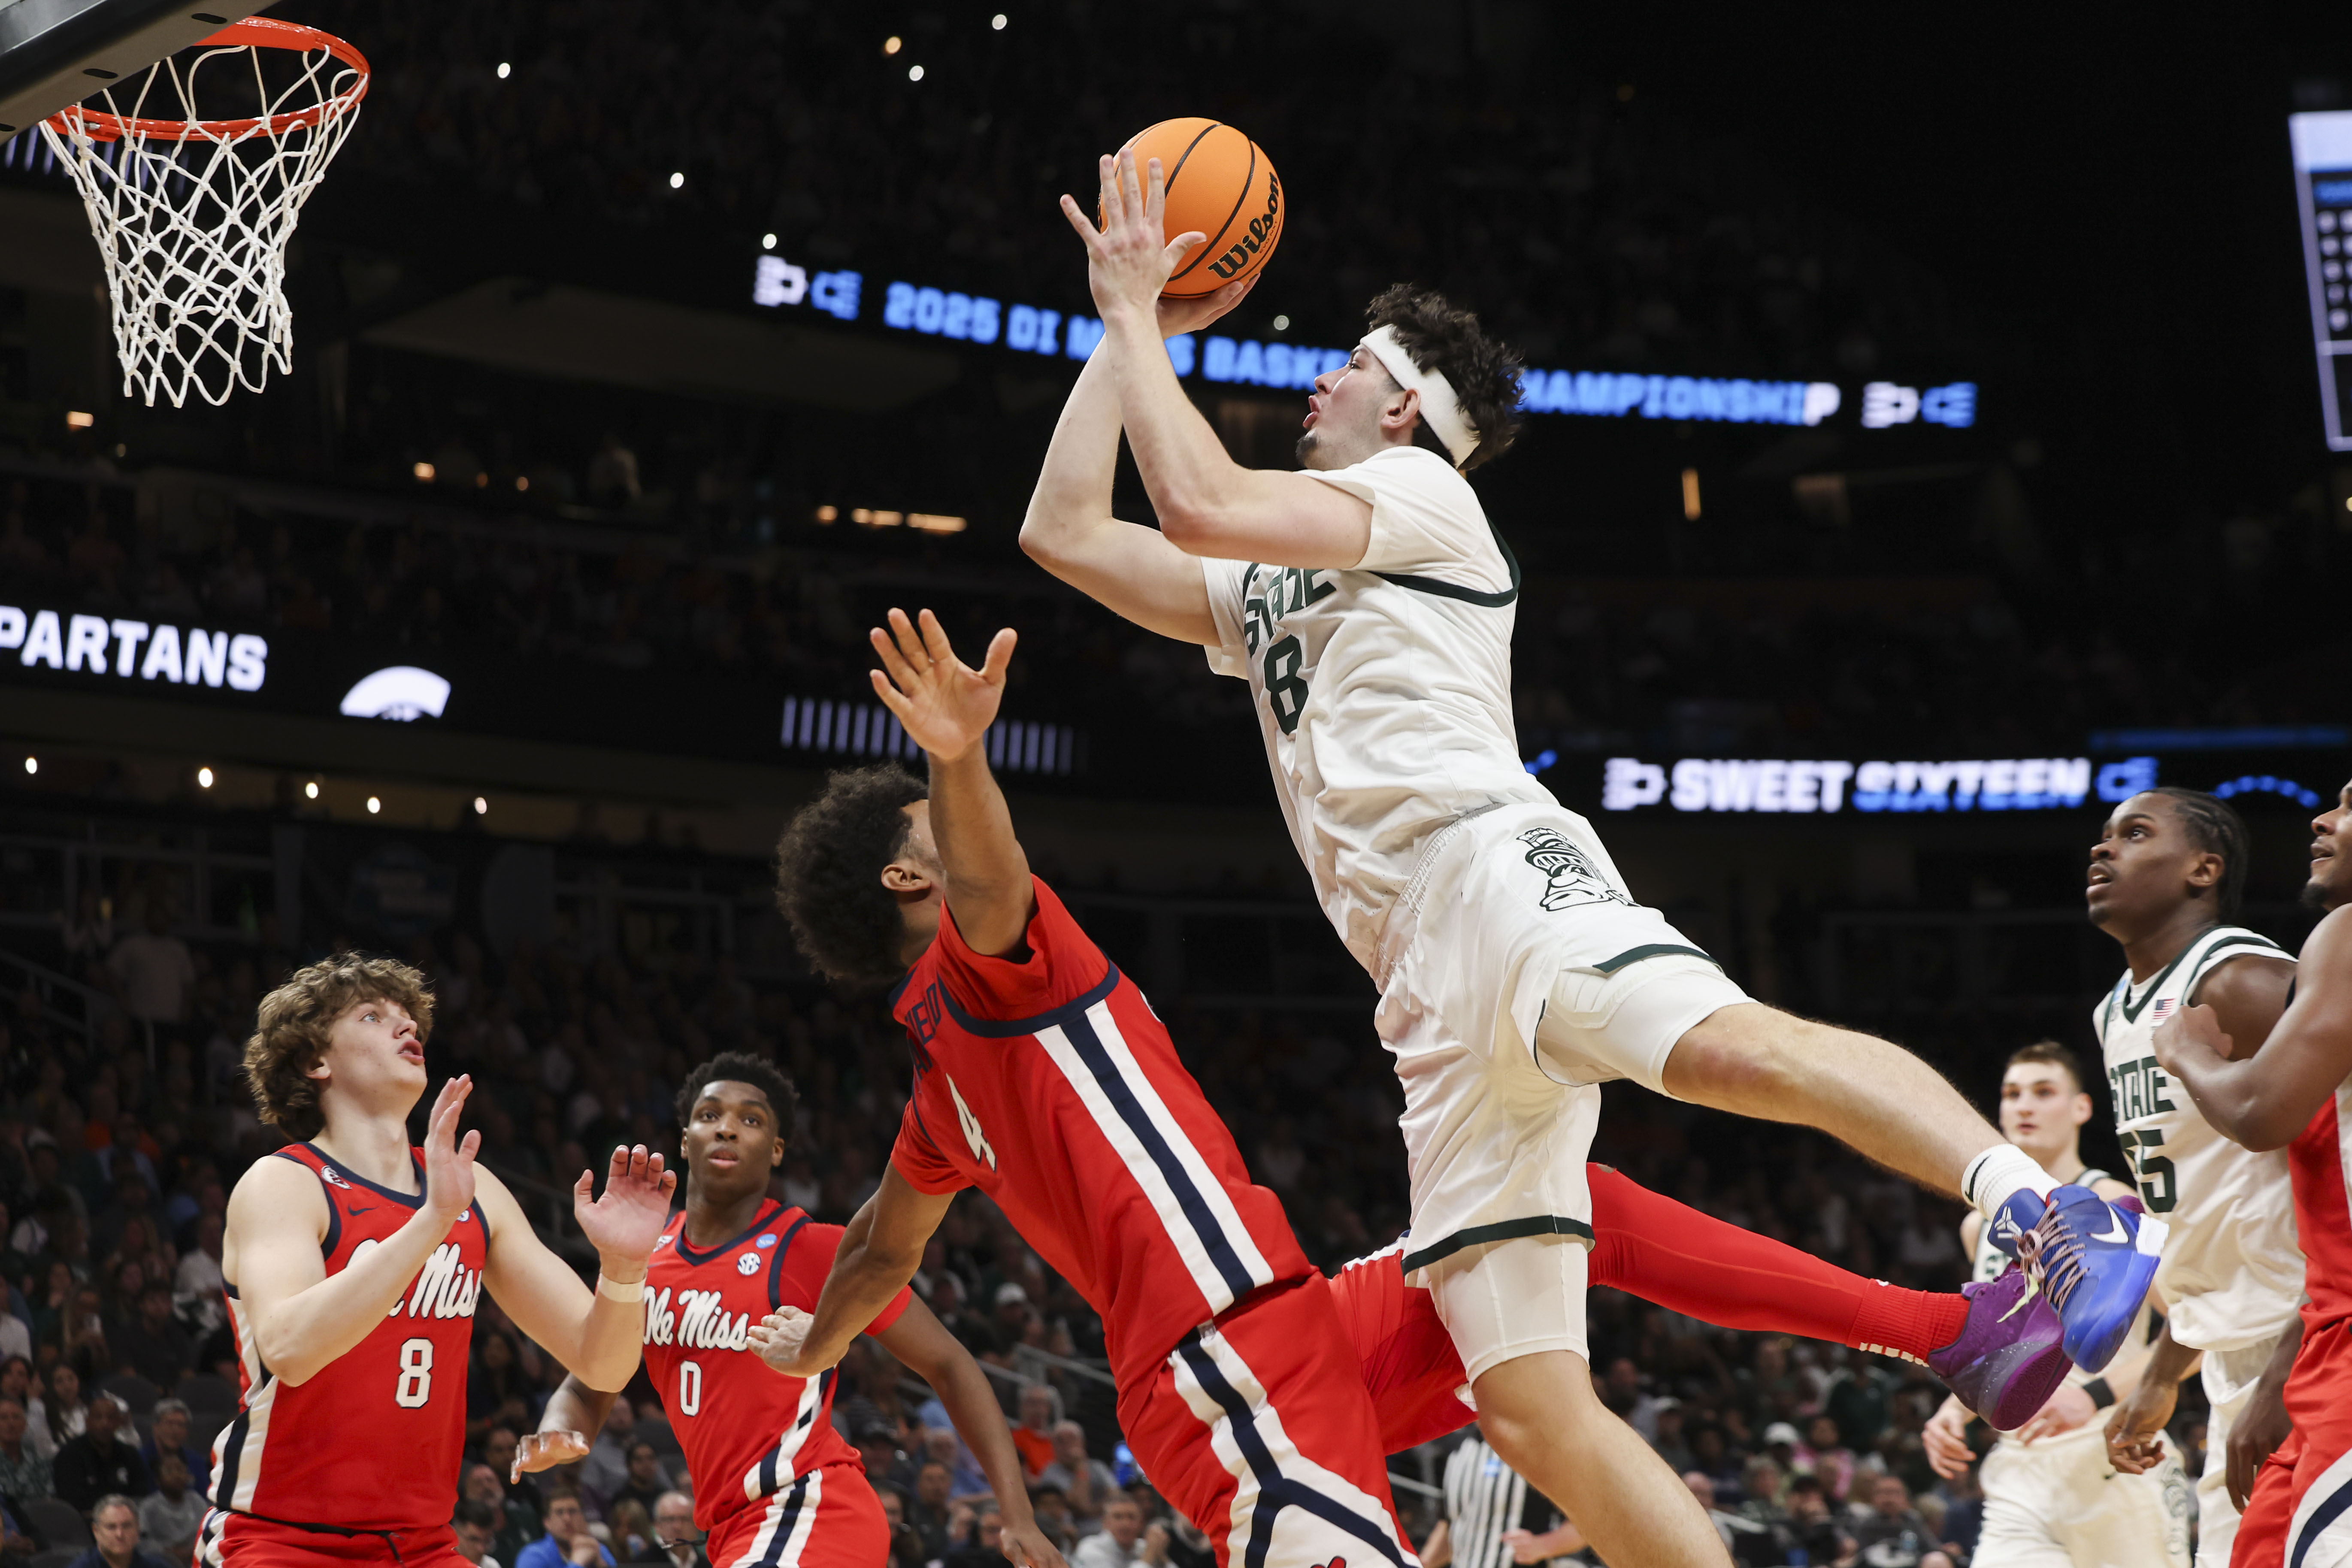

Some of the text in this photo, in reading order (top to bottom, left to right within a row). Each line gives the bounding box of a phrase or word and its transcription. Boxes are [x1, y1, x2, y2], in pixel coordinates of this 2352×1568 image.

[1207, 172, 1279, 279] Wilson
[884, 281, 1000, 343] 2025
[1514, 368, 1841, 426] HAMPIONSHIP
[1263, 634, 1309, 736] 8
[1669, 757, 2091, 813] SWEET SIXTEEN
[946, 1072, 996, 1174] 4
[409, 1242, 482, 1320] Mis
[678, 1289, 750, 1352] Miss
[395, 1338, 434, 1409] 8
[680, 1360, 702, 1417] 0
